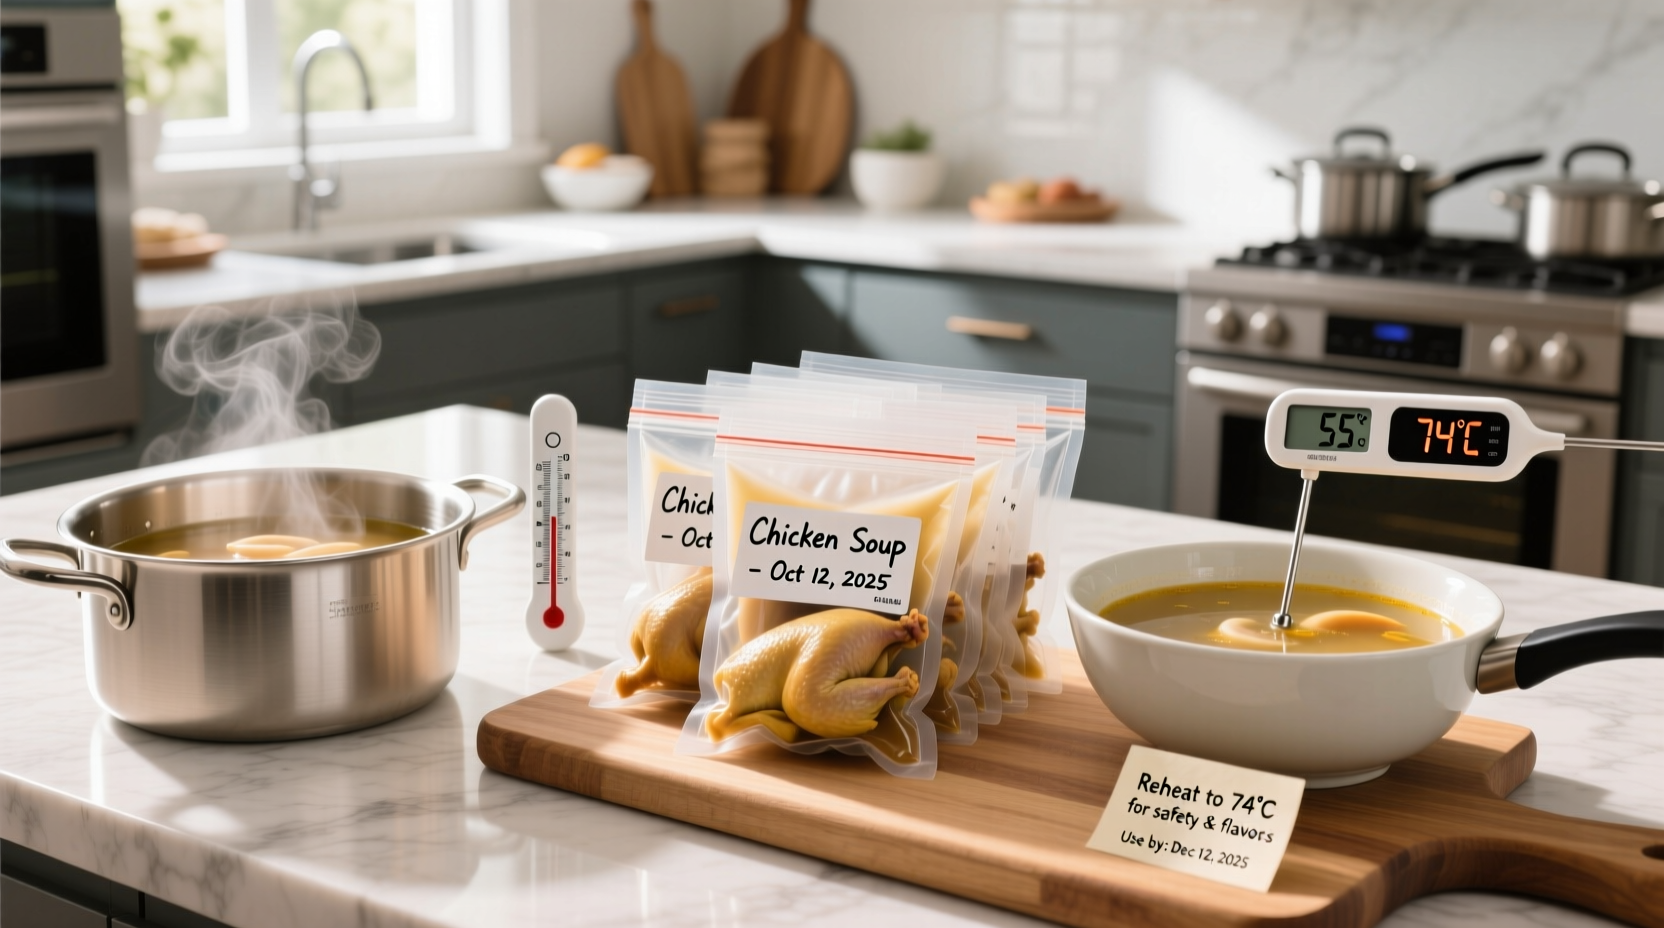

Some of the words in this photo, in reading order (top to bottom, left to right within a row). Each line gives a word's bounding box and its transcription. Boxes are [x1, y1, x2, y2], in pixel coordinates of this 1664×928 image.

[681, 526, 713, 549] Oct
[749, 516, 838, 550] Chicken
[849, 527, 906, 568] Soup
[770, 560, 805, 582] Oct
[811, 567, 835, 590] 12,
[841, 571, 891, 591] 2025
[1137, 772, 1200, 802] Reheat
[1206, 789, 1224, 807] to
[1231, 792, 1277, 819] 74°C
[1127, 797, 1151, 816] for
[1152, 806, 1199, 830] safety
[1203, 815, 1216, 830] &
[1220, 818, 1275, 843] flavors
[1120, 830, 1145, 847] Use
[1148, 834, 1169, 854] by:
[1170, 840, 1196, 858] Dec
[1198, 847, 1214, 865] 12,
[1216, 851, 1250, 869] 2025
